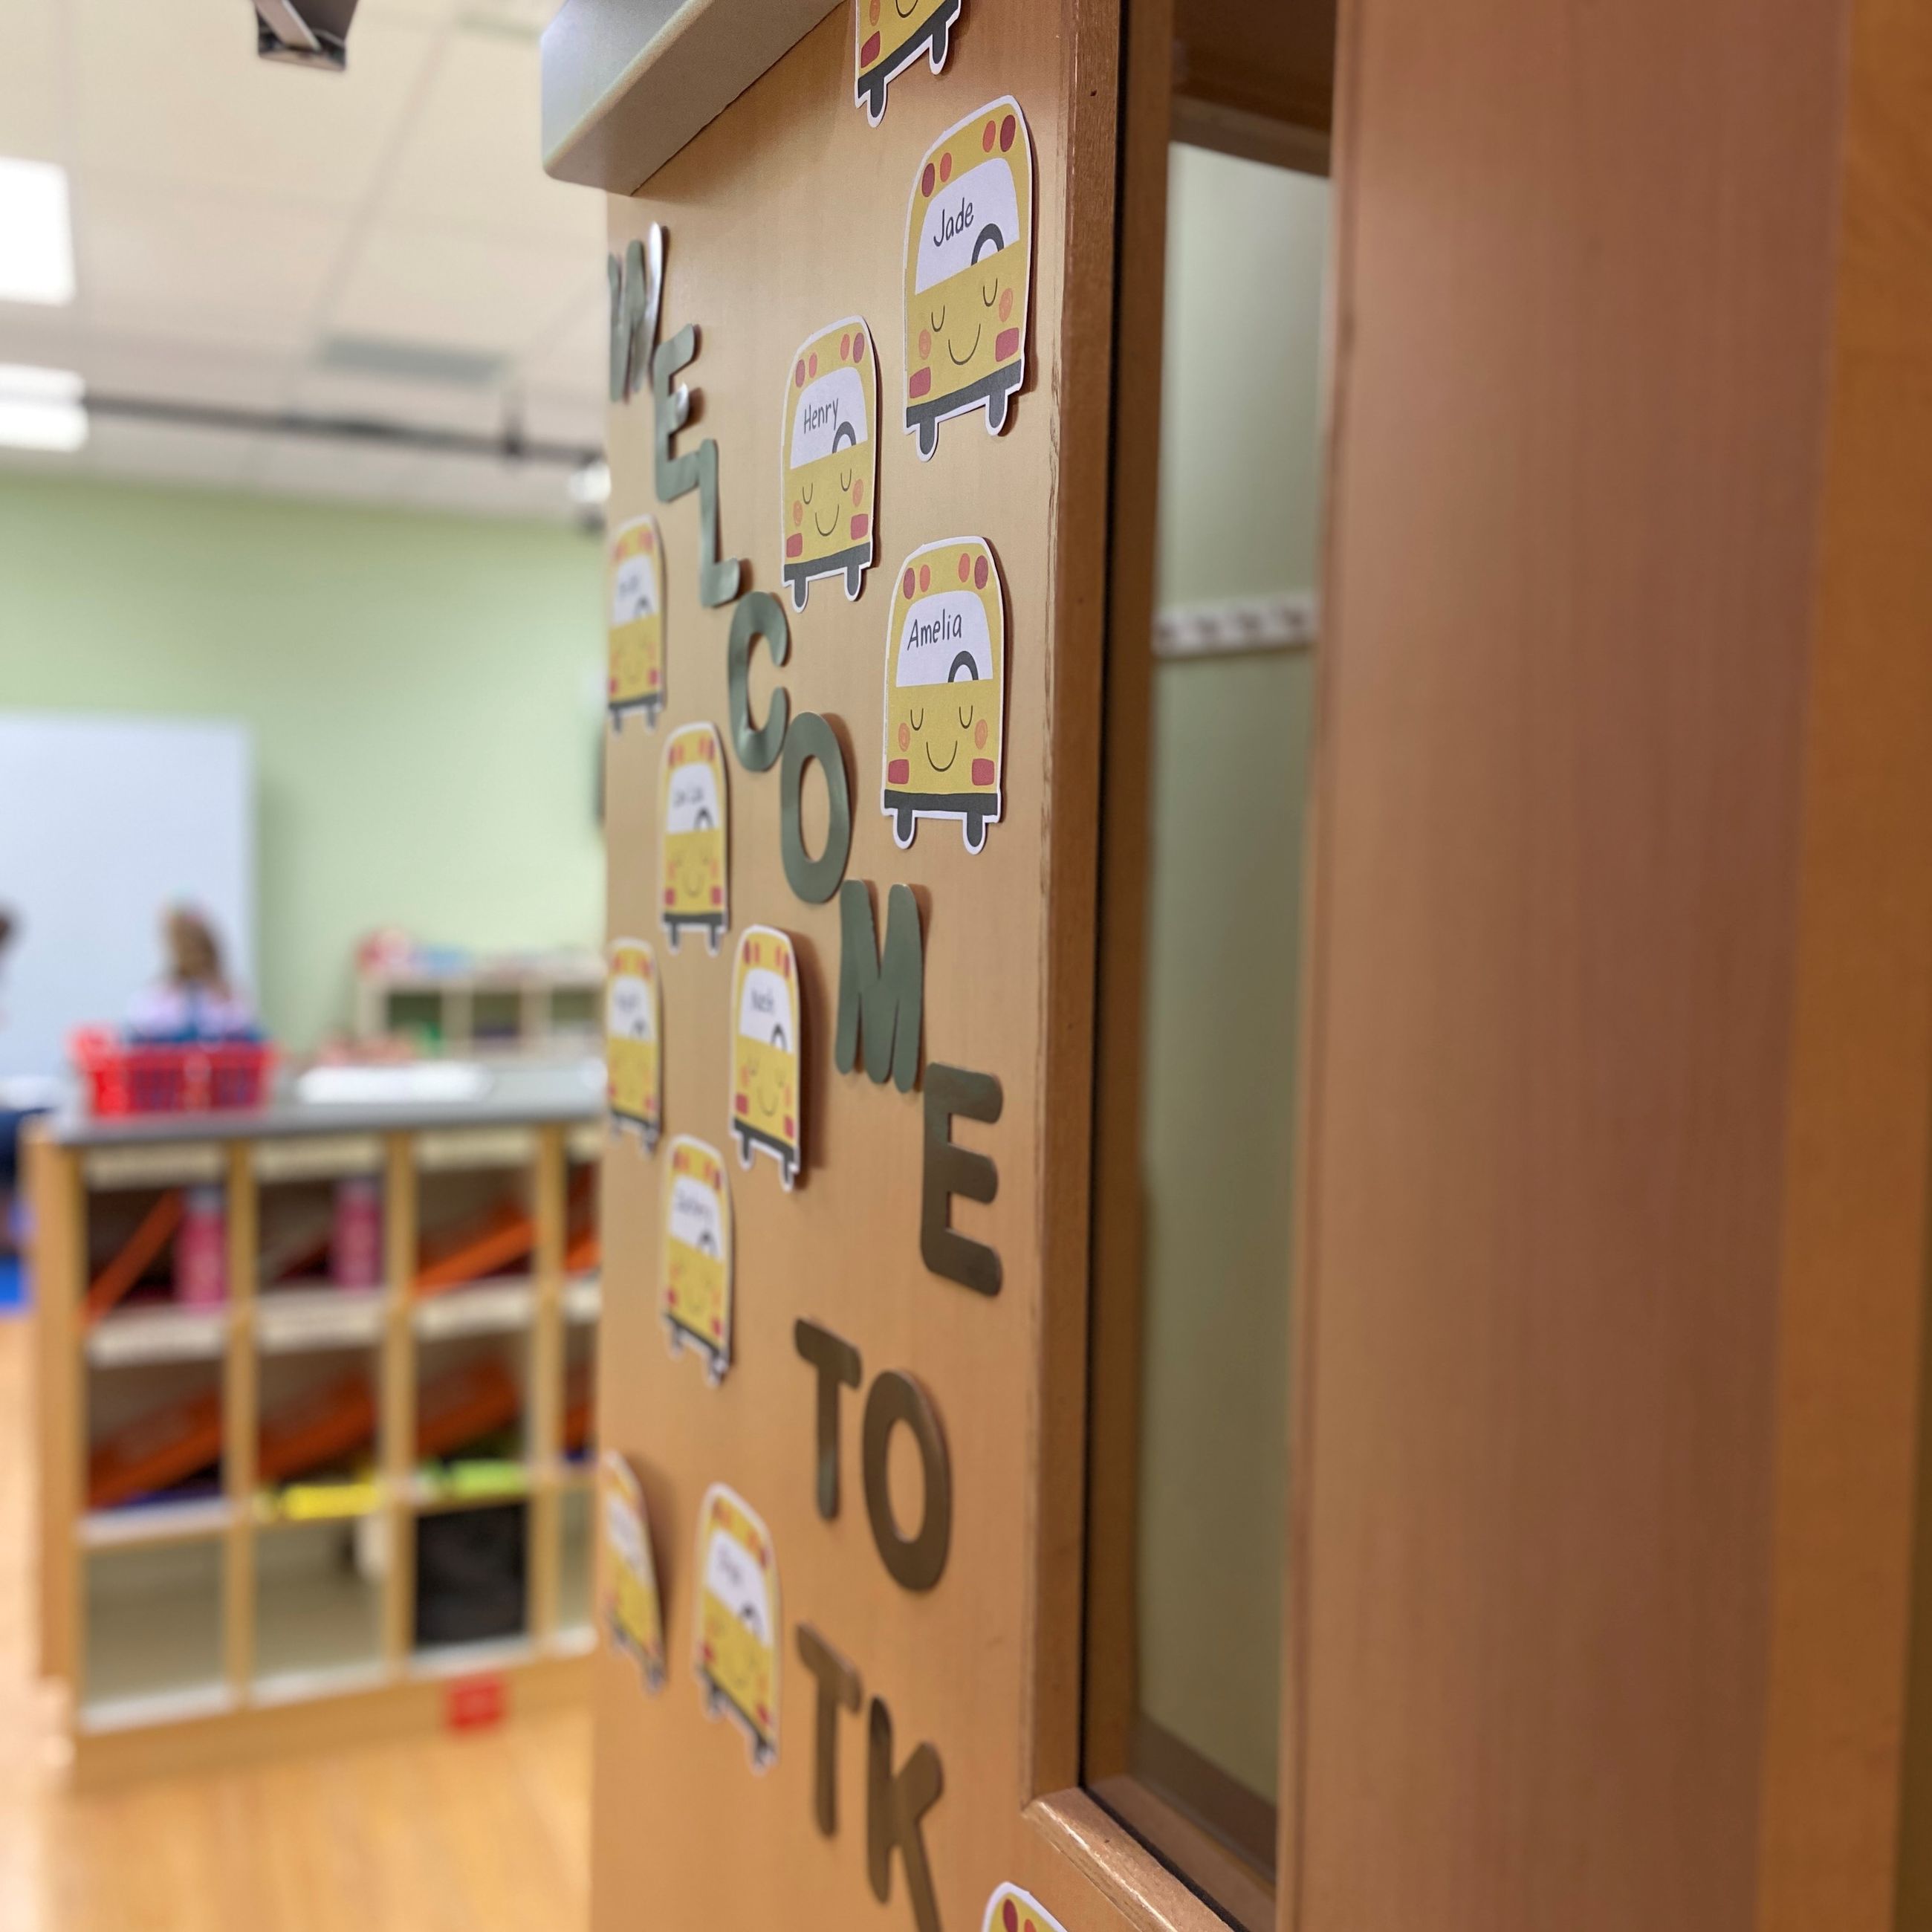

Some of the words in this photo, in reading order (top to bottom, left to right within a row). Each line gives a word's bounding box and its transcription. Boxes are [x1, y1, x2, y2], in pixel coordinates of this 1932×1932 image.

[933, 197, 974, 247] Jade
[803, 398, 839, 435] Henry
[907, 608, 962, 651] Amelia
[607, 222, 1004, 1297] WELCOME
[794, 1317, 953, 1592] TO
[796, 1622, 944, 1932] TK
